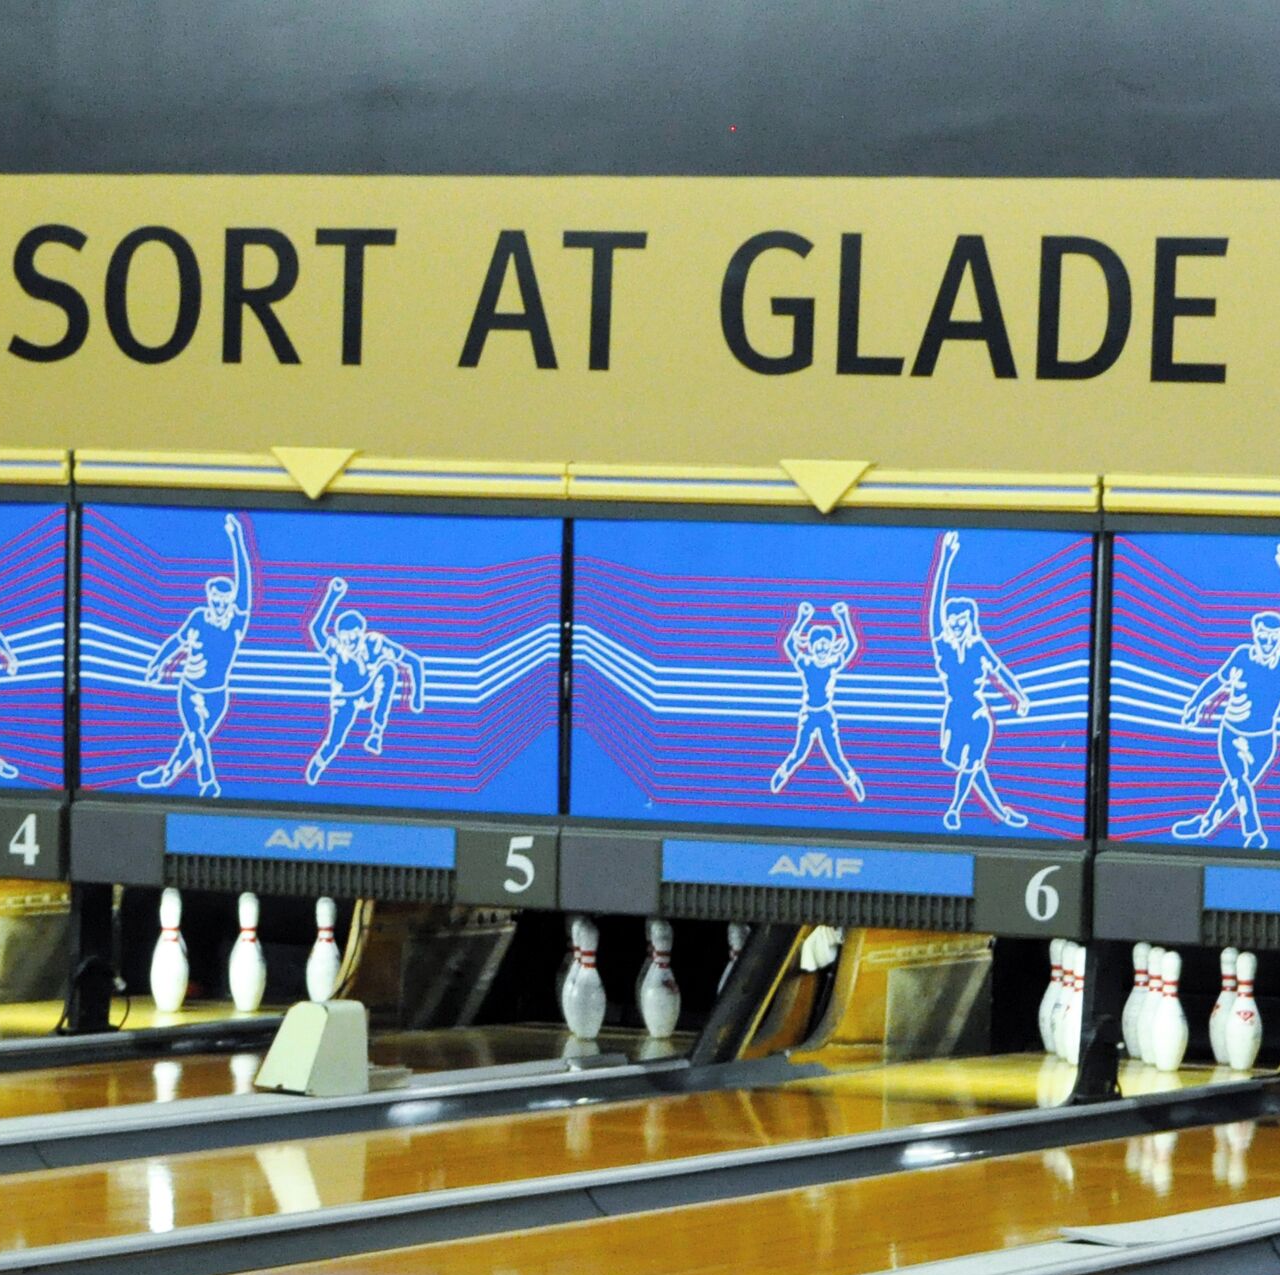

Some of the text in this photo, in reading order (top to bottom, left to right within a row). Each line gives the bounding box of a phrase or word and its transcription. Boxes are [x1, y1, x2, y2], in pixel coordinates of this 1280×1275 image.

[458, 230, 647, 371] AT
[720, 231, 1229, 384] GLADE
[8, 813, 40, 866] 4
[264, 825, 353, 851] AMF
[503, 836, 535, 893] 5
[767, 852, 864, 878] AMF
[1024, 865, 1061, 922] 6
